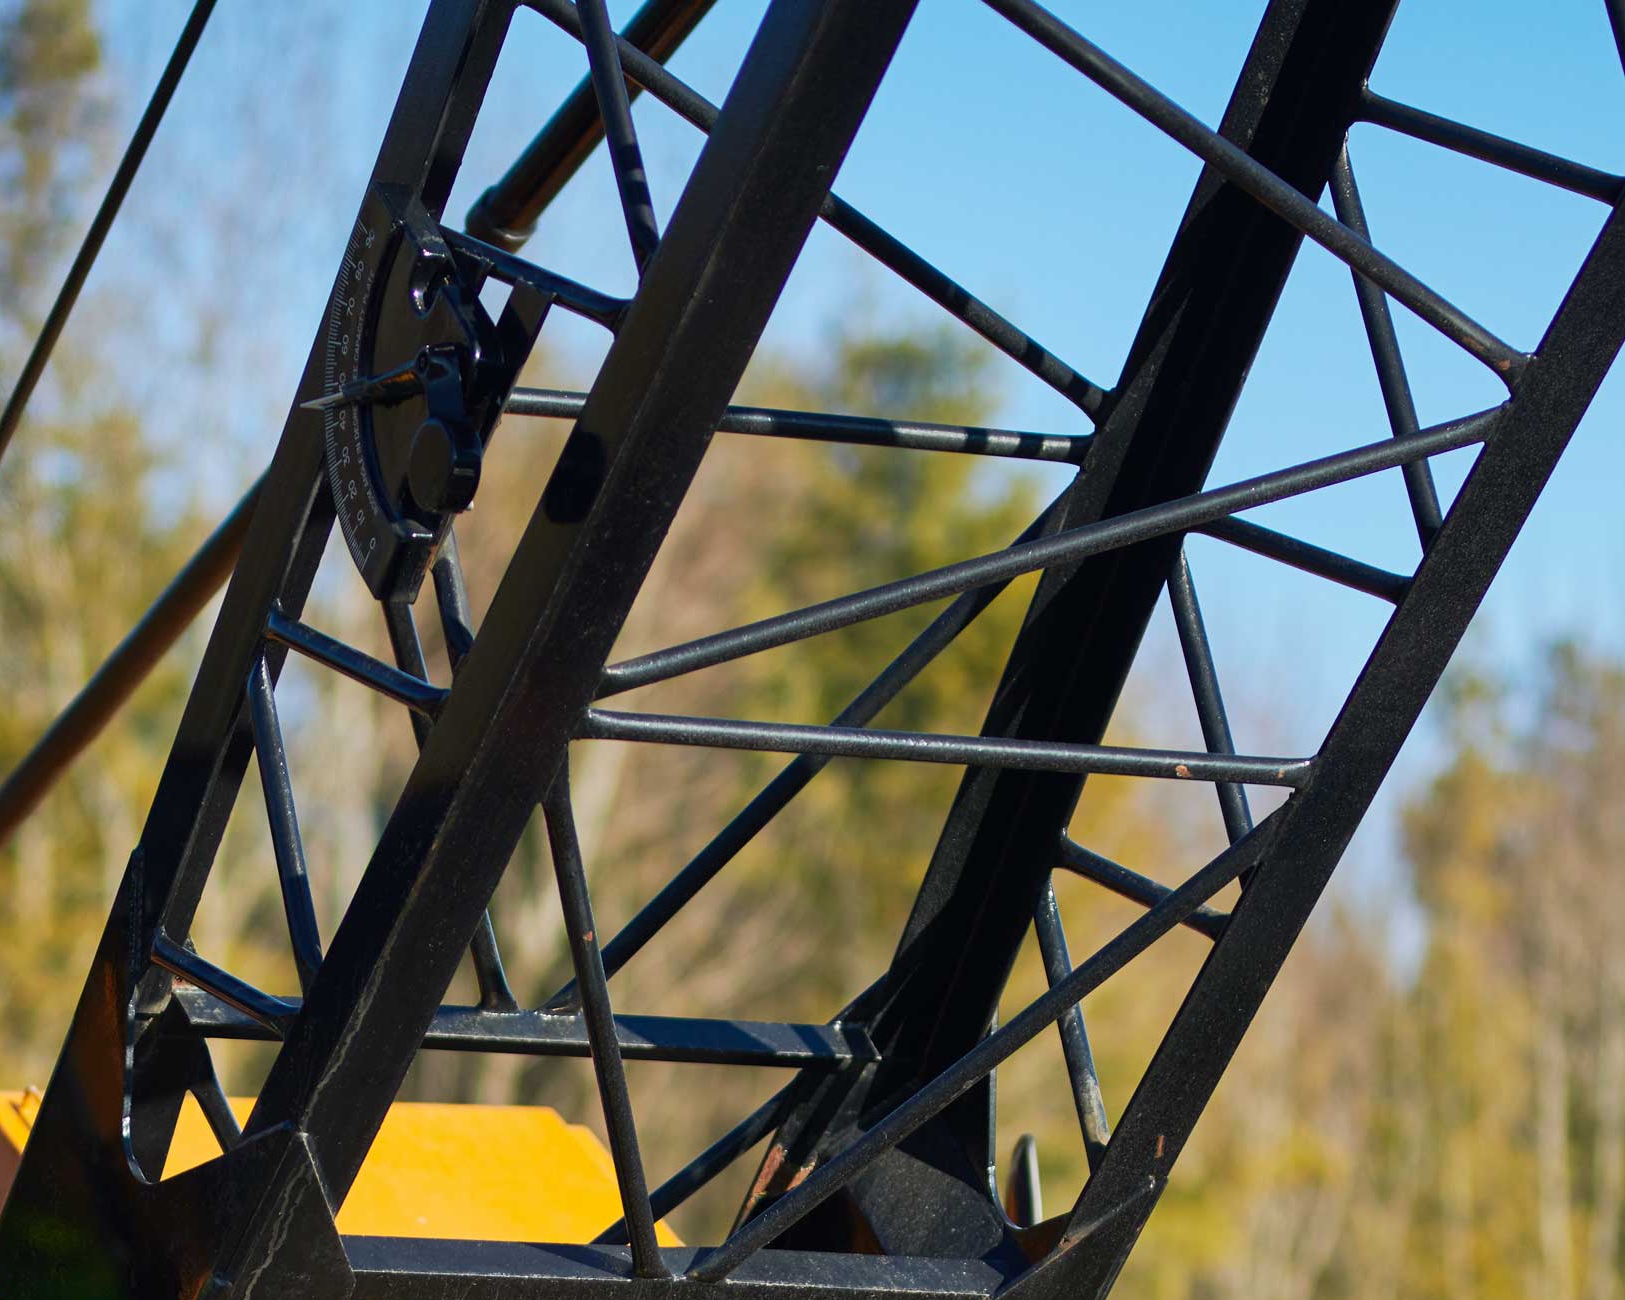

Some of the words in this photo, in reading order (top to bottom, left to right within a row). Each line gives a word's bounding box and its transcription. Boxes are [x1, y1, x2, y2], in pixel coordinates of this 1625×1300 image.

[355, 260, 365, 281] 80
[347, 297, 356, 316] 70
[341, 334, 349, 355] 60
[339, 410, 346, 430] 40
[343, 446, 350, 466] 30
[348, 479, 357, 499] 20
[357, 509, 365, 526] 10
[369, 537, 376, 550] 0
